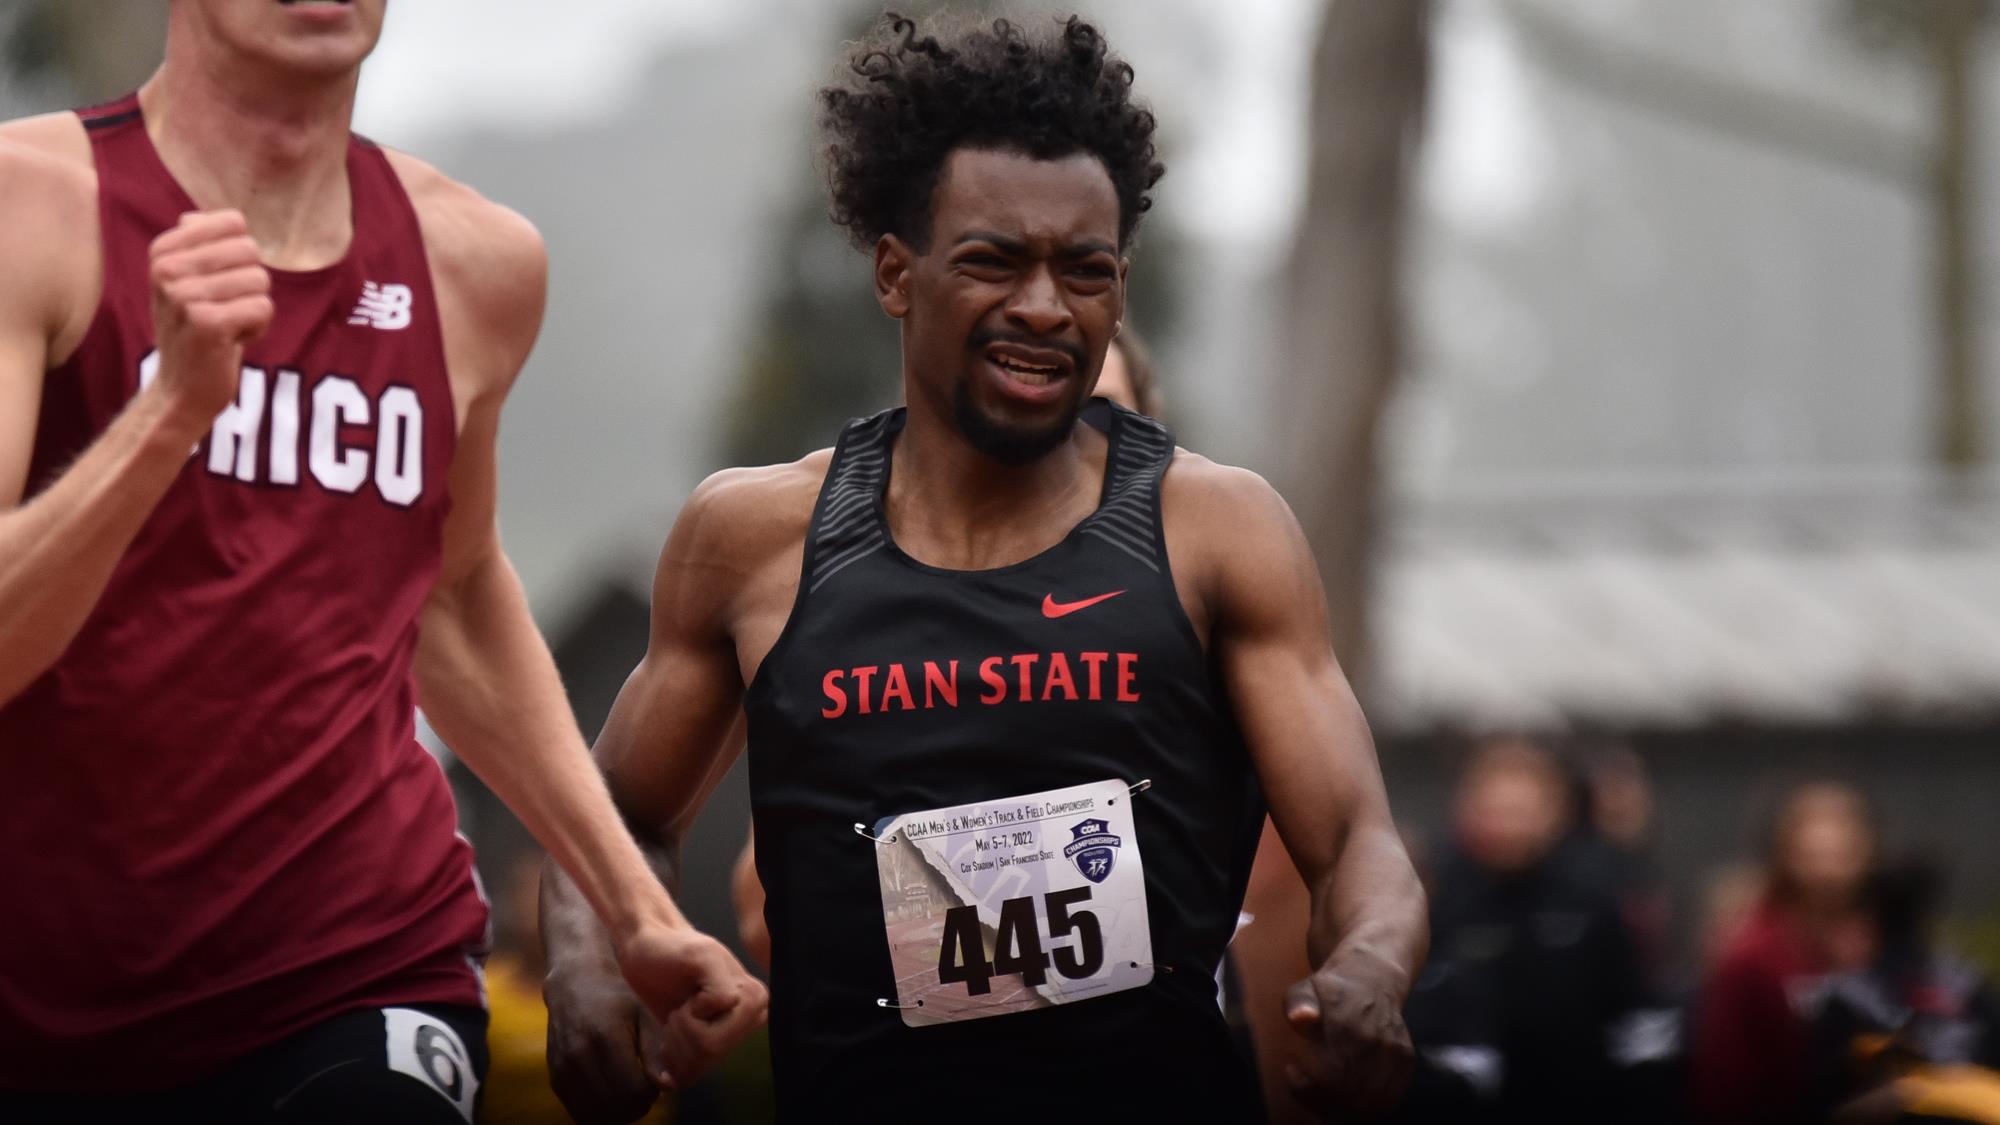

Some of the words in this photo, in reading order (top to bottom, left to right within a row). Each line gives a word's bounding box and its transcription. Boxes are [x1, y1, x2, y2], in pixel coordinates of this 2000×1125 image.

[140, 350, 423, 506] HICO
[821, 659, 959, 719] STAN
[978, 652, 1141, 705] STATE
[907, 822, 928, 837] CCAA
[952, 818, 960, 831] &
[1017, 807, 1024, 820] &
[1012, 831, 1034, 846] 2022
[938, 885, 1104, 997] 445
[414, 1024, 465, 1102] 6
